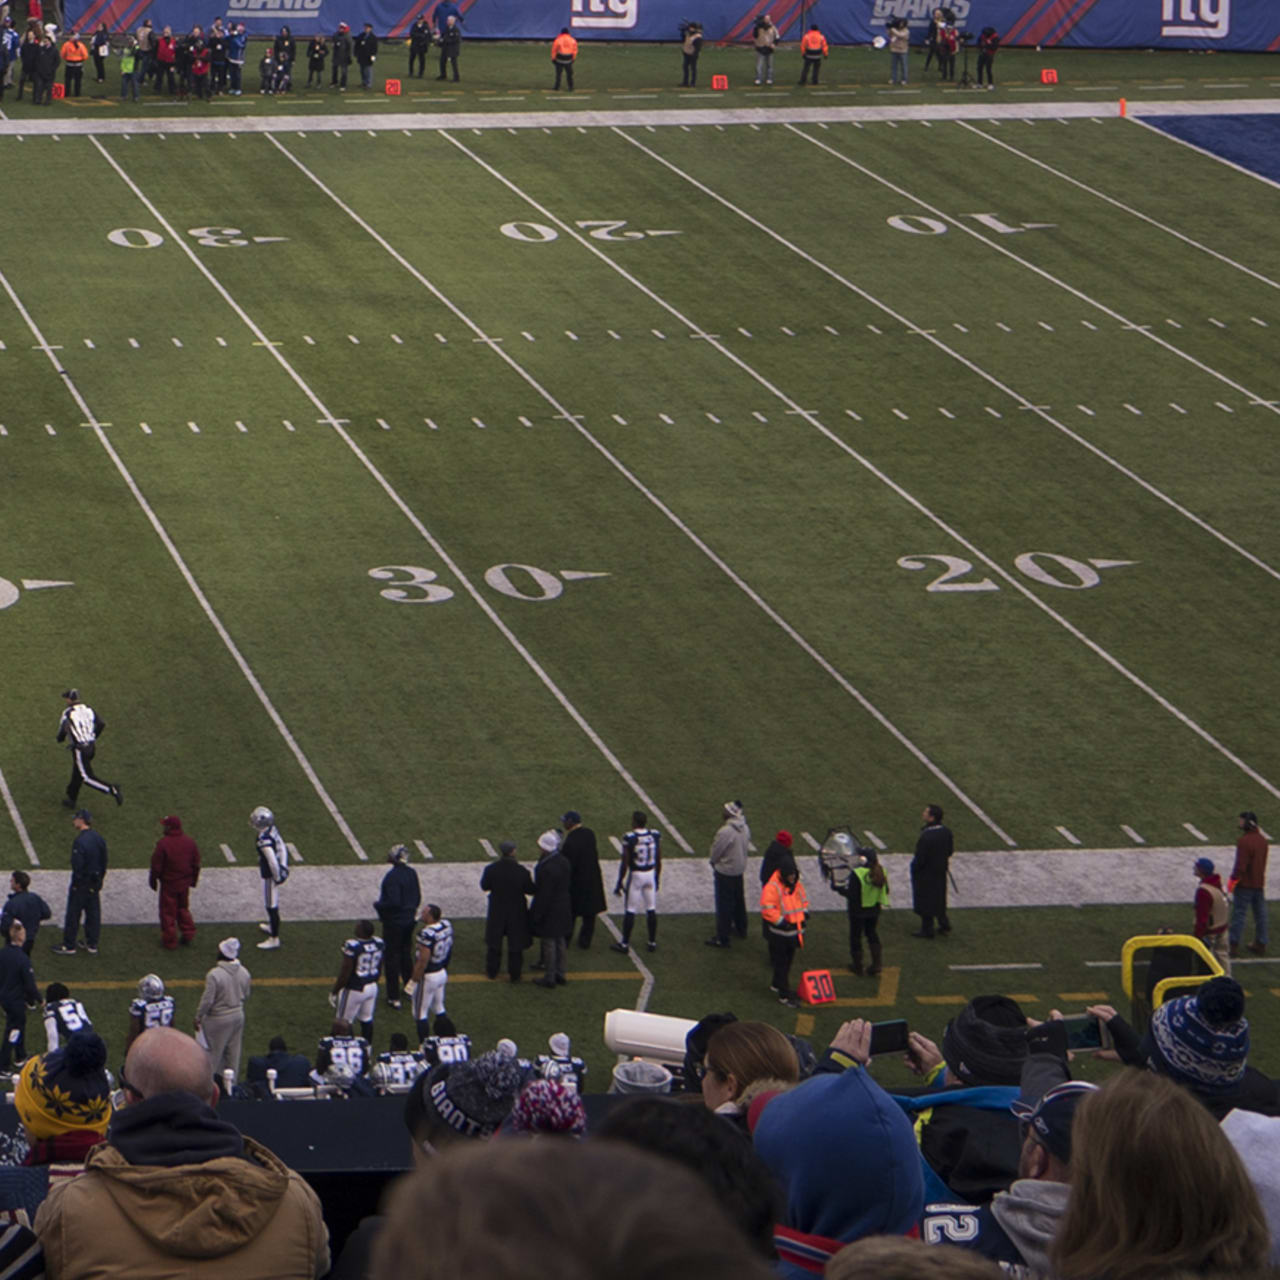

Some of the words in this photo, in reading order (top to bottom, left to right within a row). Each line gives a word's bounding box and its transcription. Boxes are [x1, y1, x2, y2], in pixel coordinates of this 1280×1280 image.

[367, 562, 562, 603] 30
[896, 551, 1100, 592] 20
[807, 974, 833, 1000] 30
[431, 1080, 492, 1138] GIANT
